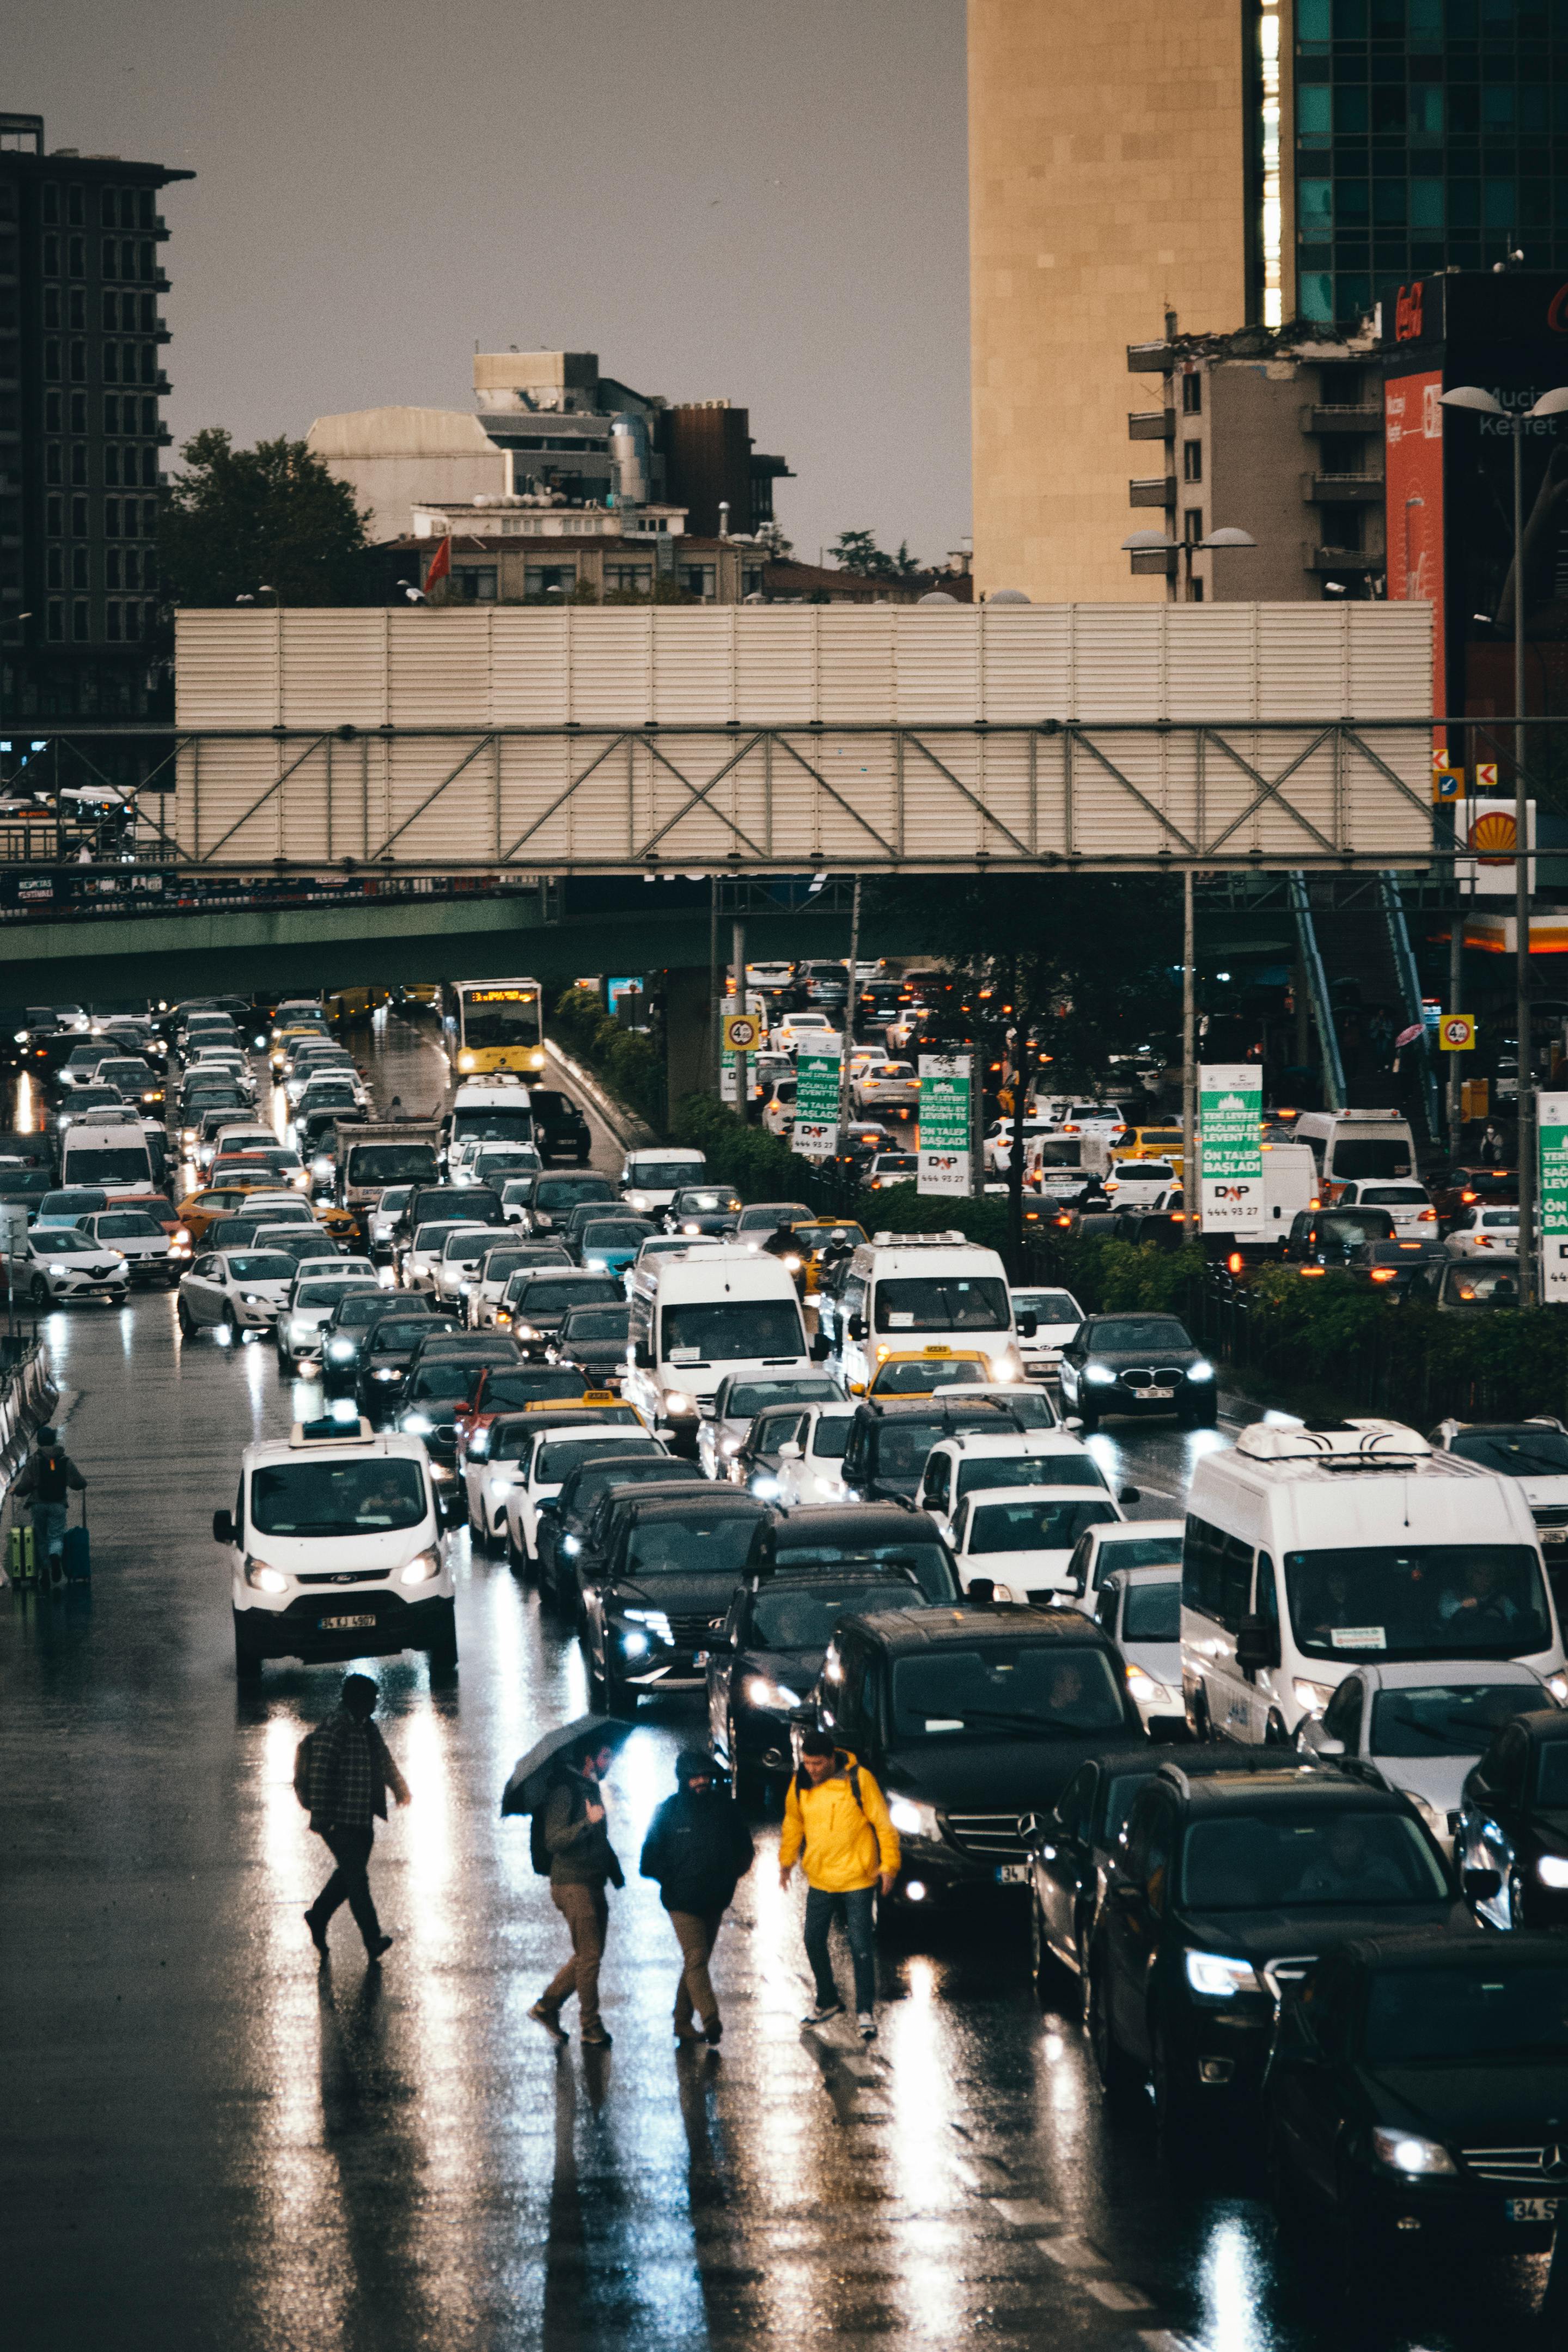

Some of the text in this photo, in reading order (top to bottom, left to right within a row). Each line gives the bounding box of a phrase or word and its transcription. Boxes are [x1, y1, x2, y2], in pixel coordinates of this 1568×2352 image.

[734, 1026, 741, 1038] 4
[1449, 1026, 1457, 1038] 4
[920, 1126, 935, 1135] ÖN
[1204, 1149, 1260, 1160] ÖN TALEP
[1204, 1162, 1260, 1175] BAŞLADI
[1215, 1186, 1249, 1202] DAP
[1544, 1198, 1567, 1212] ÖN
[1207, 1207, 1258, 1216] 444 93 27
[1516, 2200, 1538, 2220] 34
